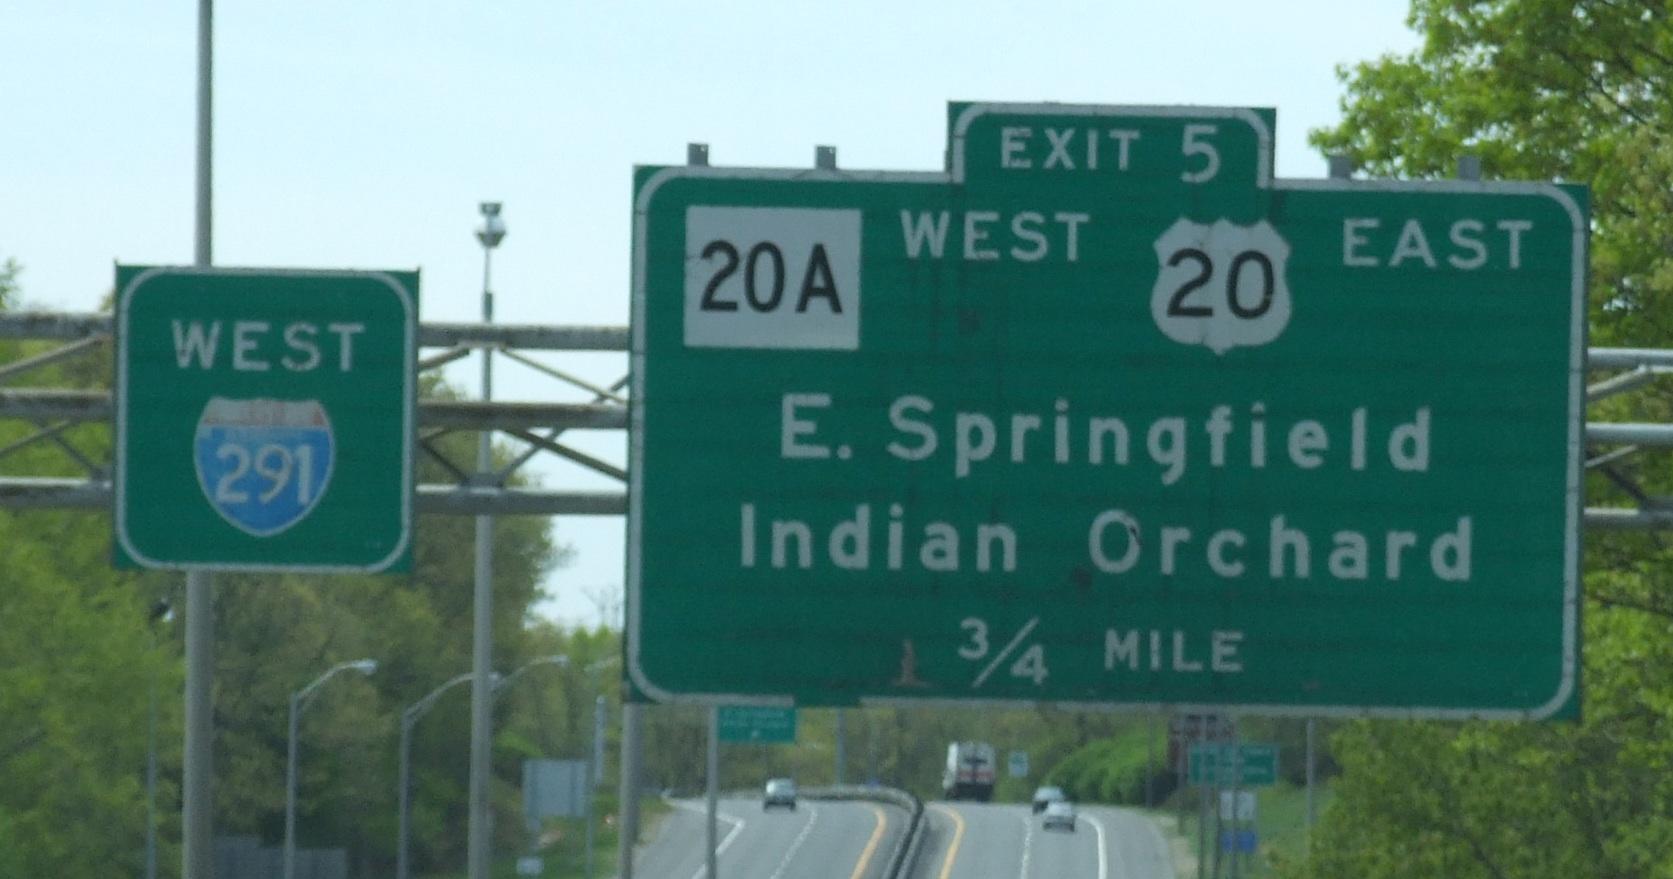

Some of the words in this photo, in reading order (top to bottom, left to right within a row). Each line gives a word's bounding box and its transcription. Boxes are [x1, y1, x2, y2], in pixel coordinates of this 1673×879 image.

[1001, 126, 1141, 170] EXIT
[1181, 123, 1221, 184] 5
[700, 239, 843, 314] 20A
[900, 209, 1090, 262] WEST
[1166, 247, 1275, 321] 20
[1342, 217, 1533, 270] EAST
[172, 319, 365, 372] WEST
[216, 442, 315, 505] 291
[781, 392, 852, 460] E.
[887, 394, 1431, 486] Springfield
[740, 503, 1017, 573] Indian
[1088, 509, 1472, 582] Orchard
[1104, 628, 1244, 673] MILE
